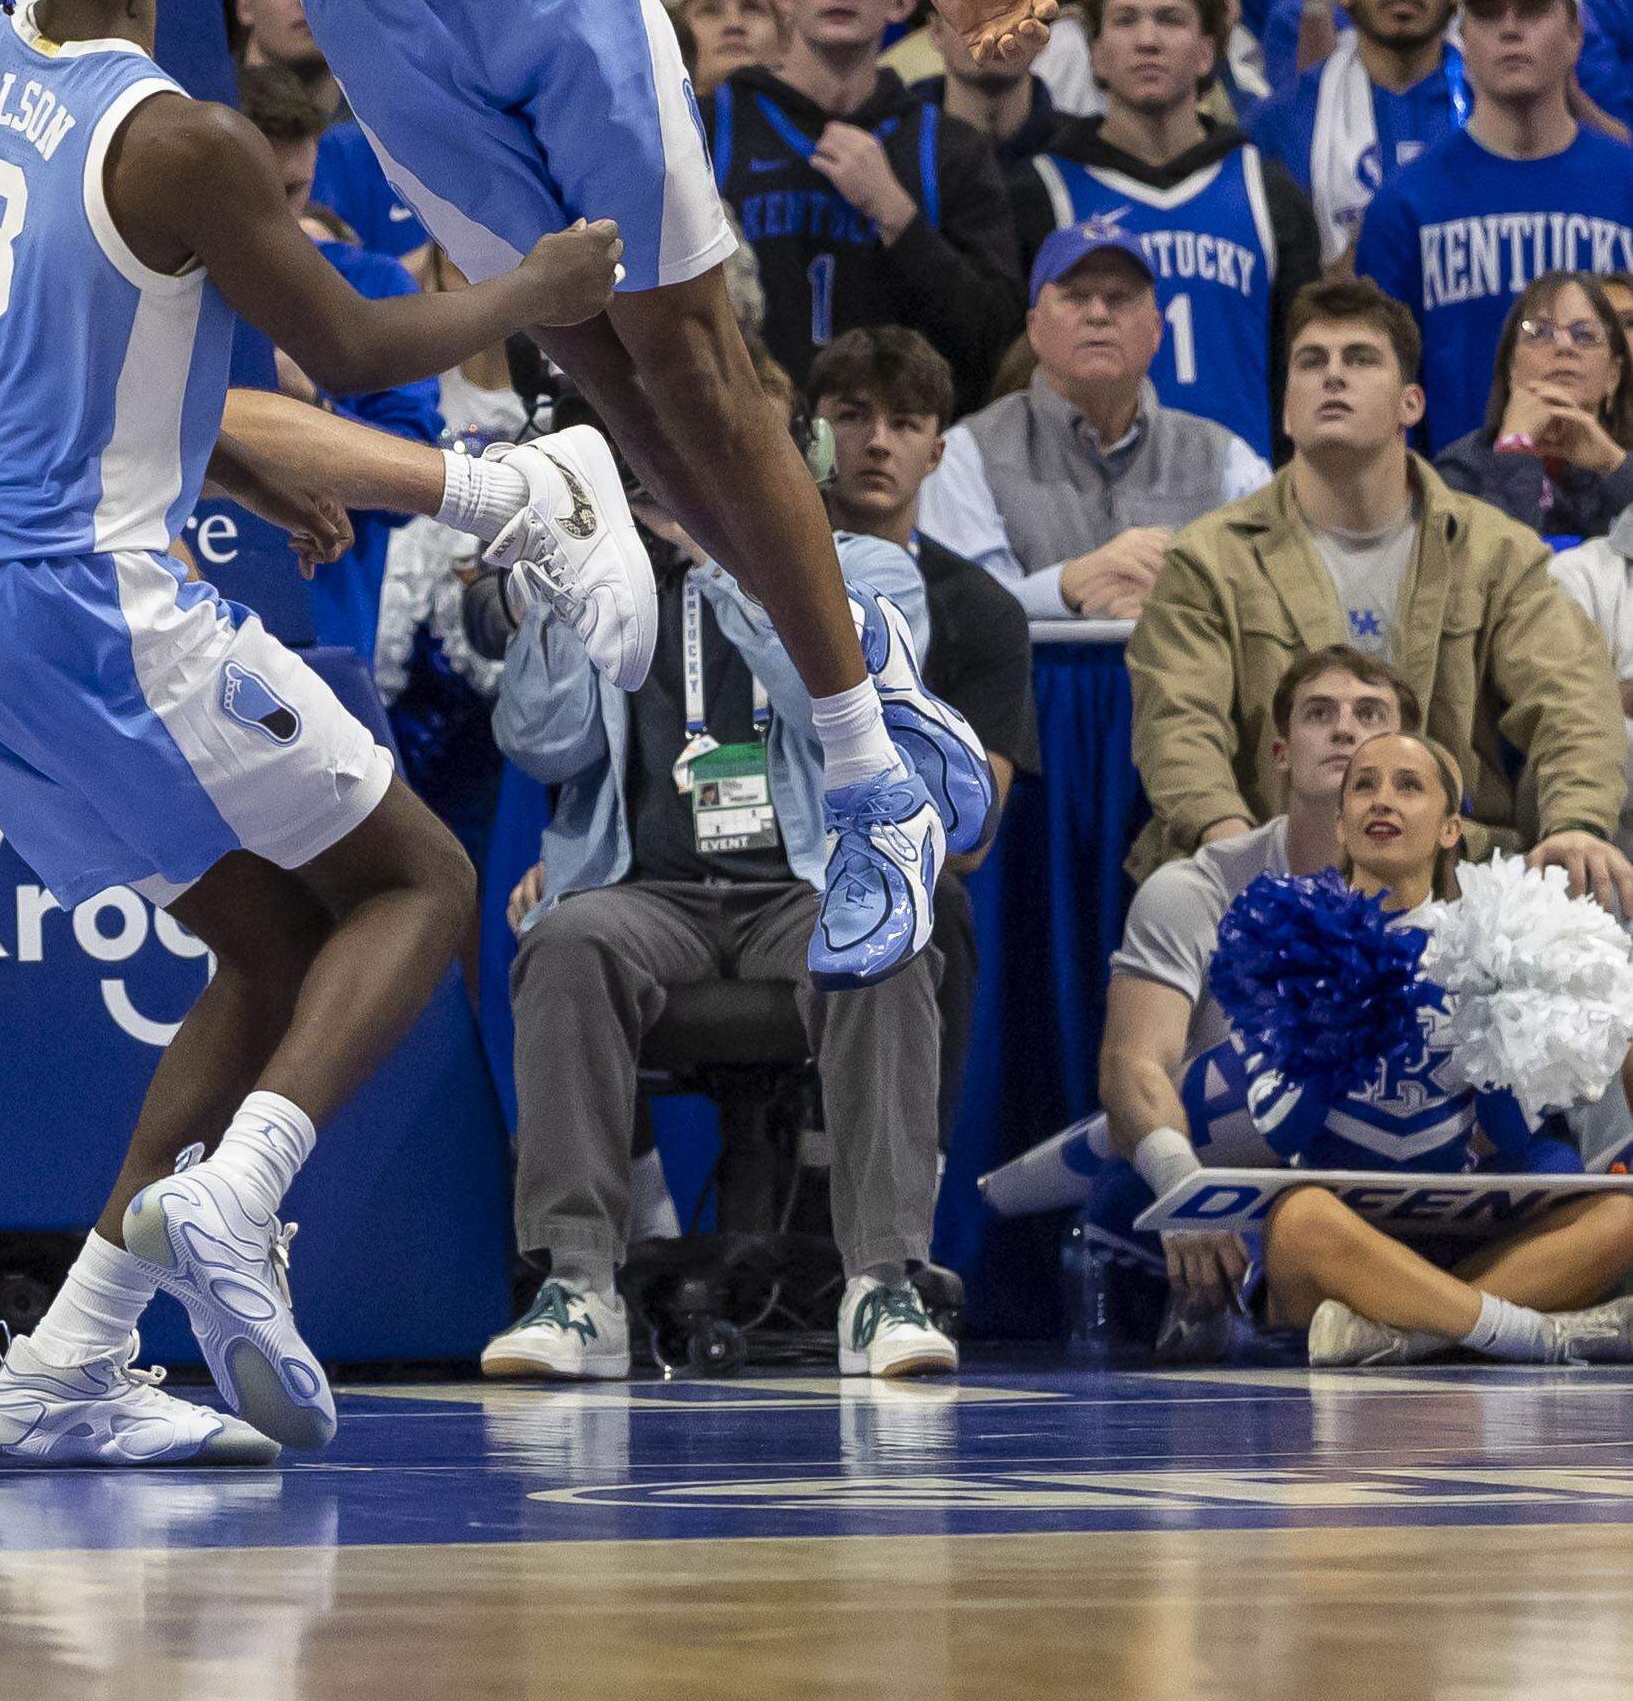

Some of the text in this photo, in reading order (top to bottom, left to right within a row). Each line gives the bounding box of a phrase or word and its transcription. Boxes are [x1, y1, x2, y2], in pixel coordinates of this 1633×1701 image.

[807, 253, 836, 346] 1
[1166, 293, 1198, 385] 1
[685, 584, 700, 694] ENTUCKY
[700, 833, 750, 852] EVENT
[1170, 1184, 1550, 1221] DFEN
